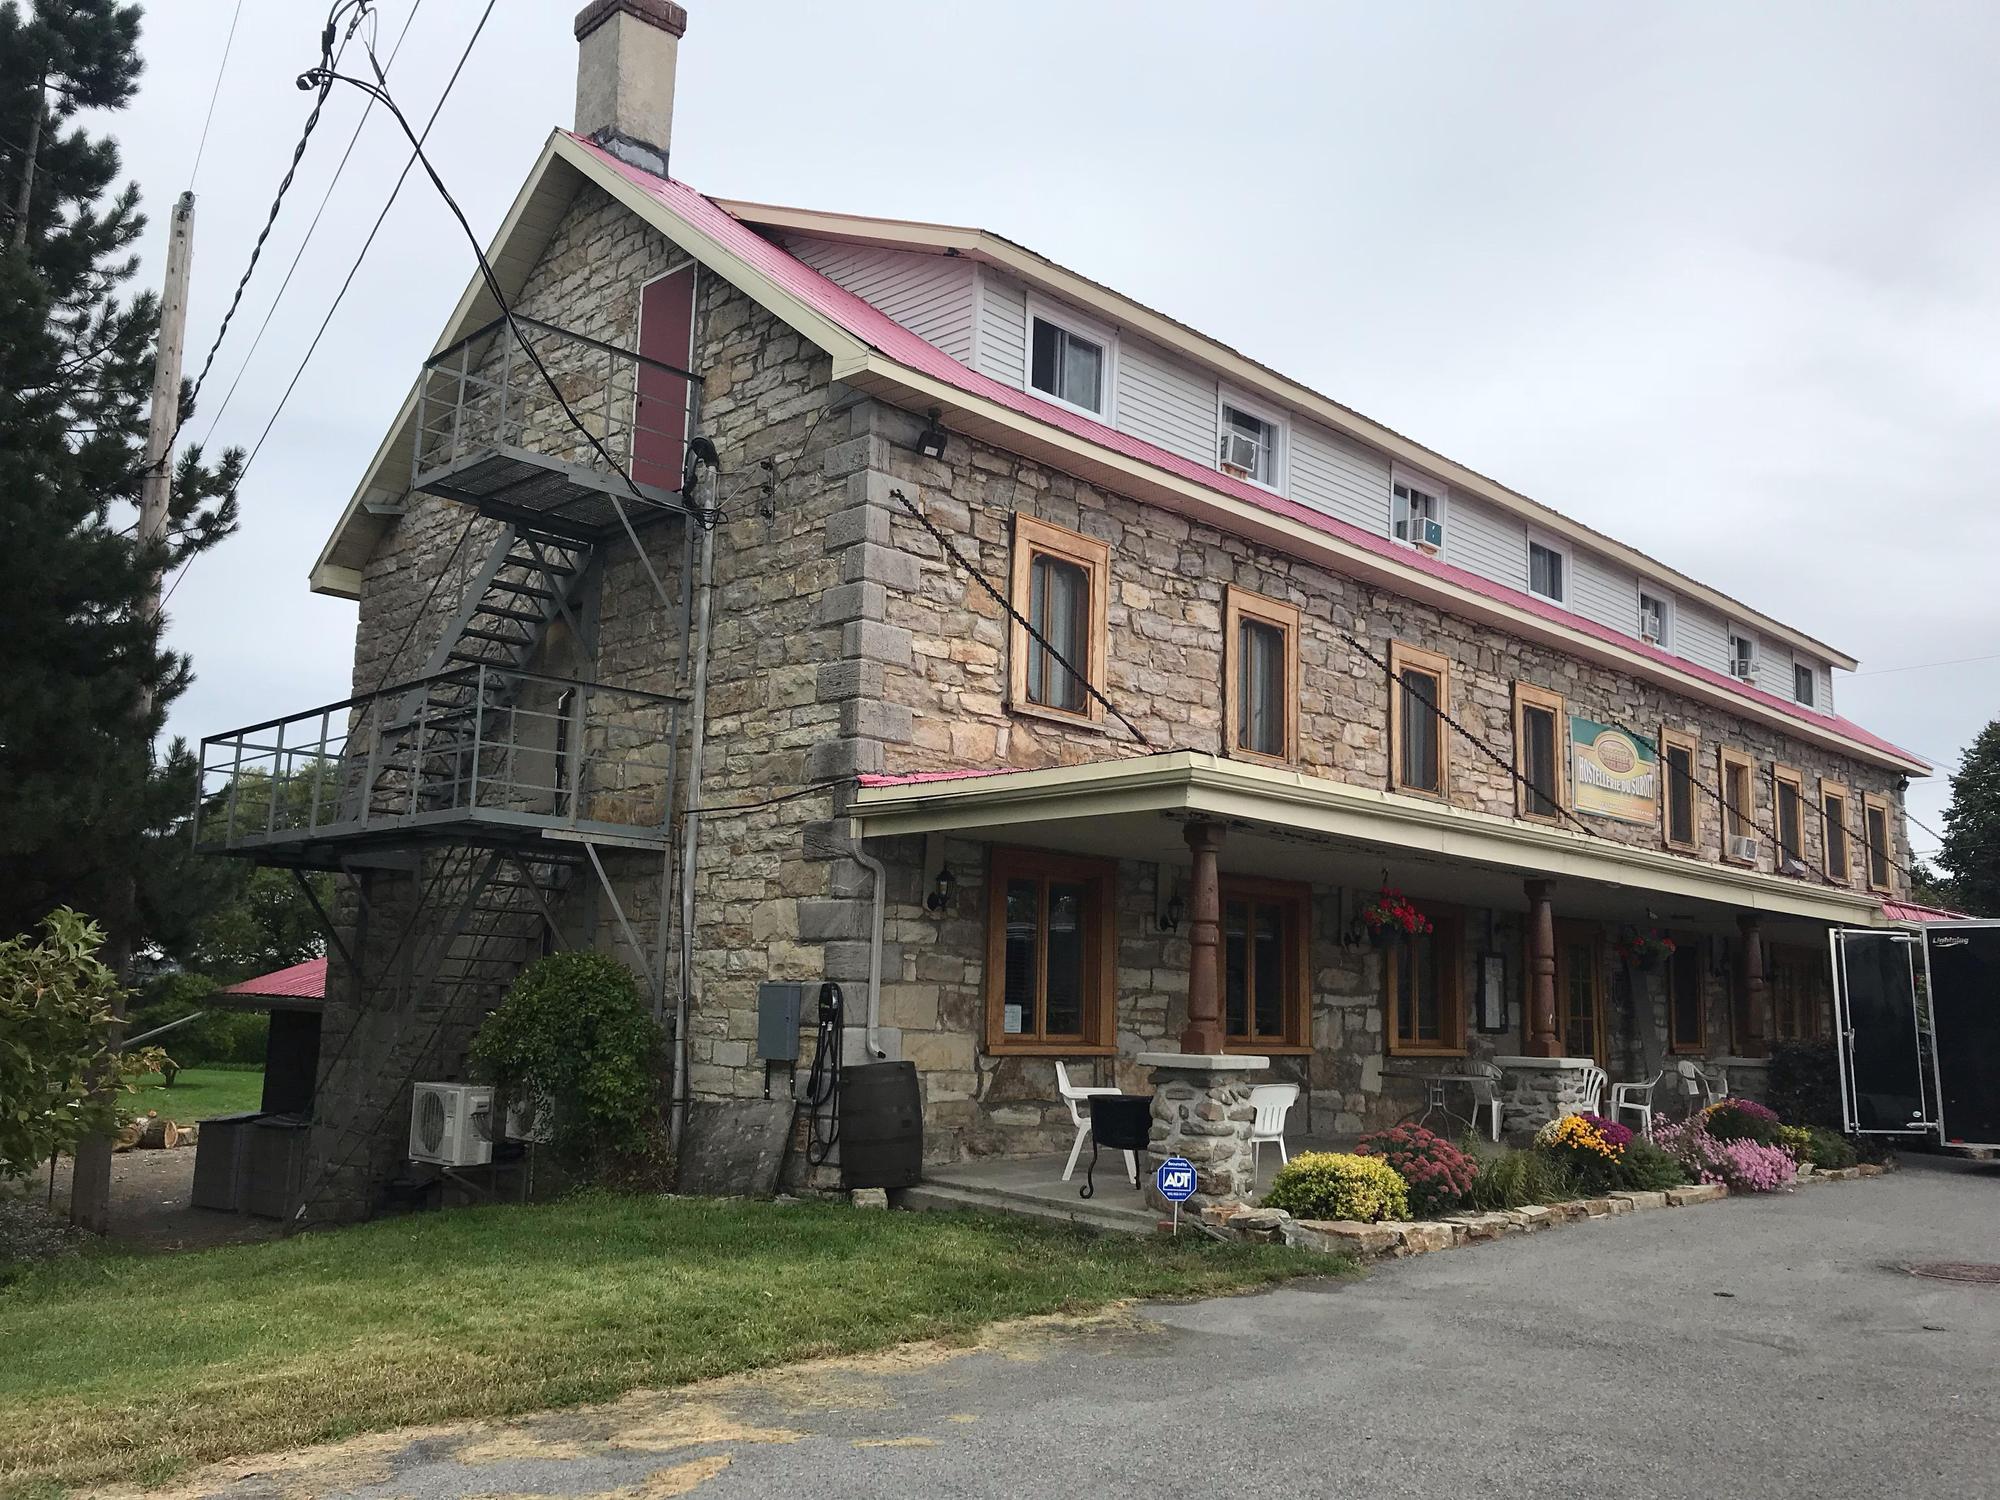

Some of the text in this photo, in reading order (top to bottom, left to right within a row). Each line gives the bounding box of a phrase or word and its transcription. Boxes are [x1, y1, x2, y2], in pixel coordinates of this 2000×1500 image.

[1579, 755, 1621, 791] HOSTELLERIE
[1621, 779, 1631, 794] DU
[1932, 936, 1969, 944] Lightning
[1164, 1172, 1190, 1188] ADT
